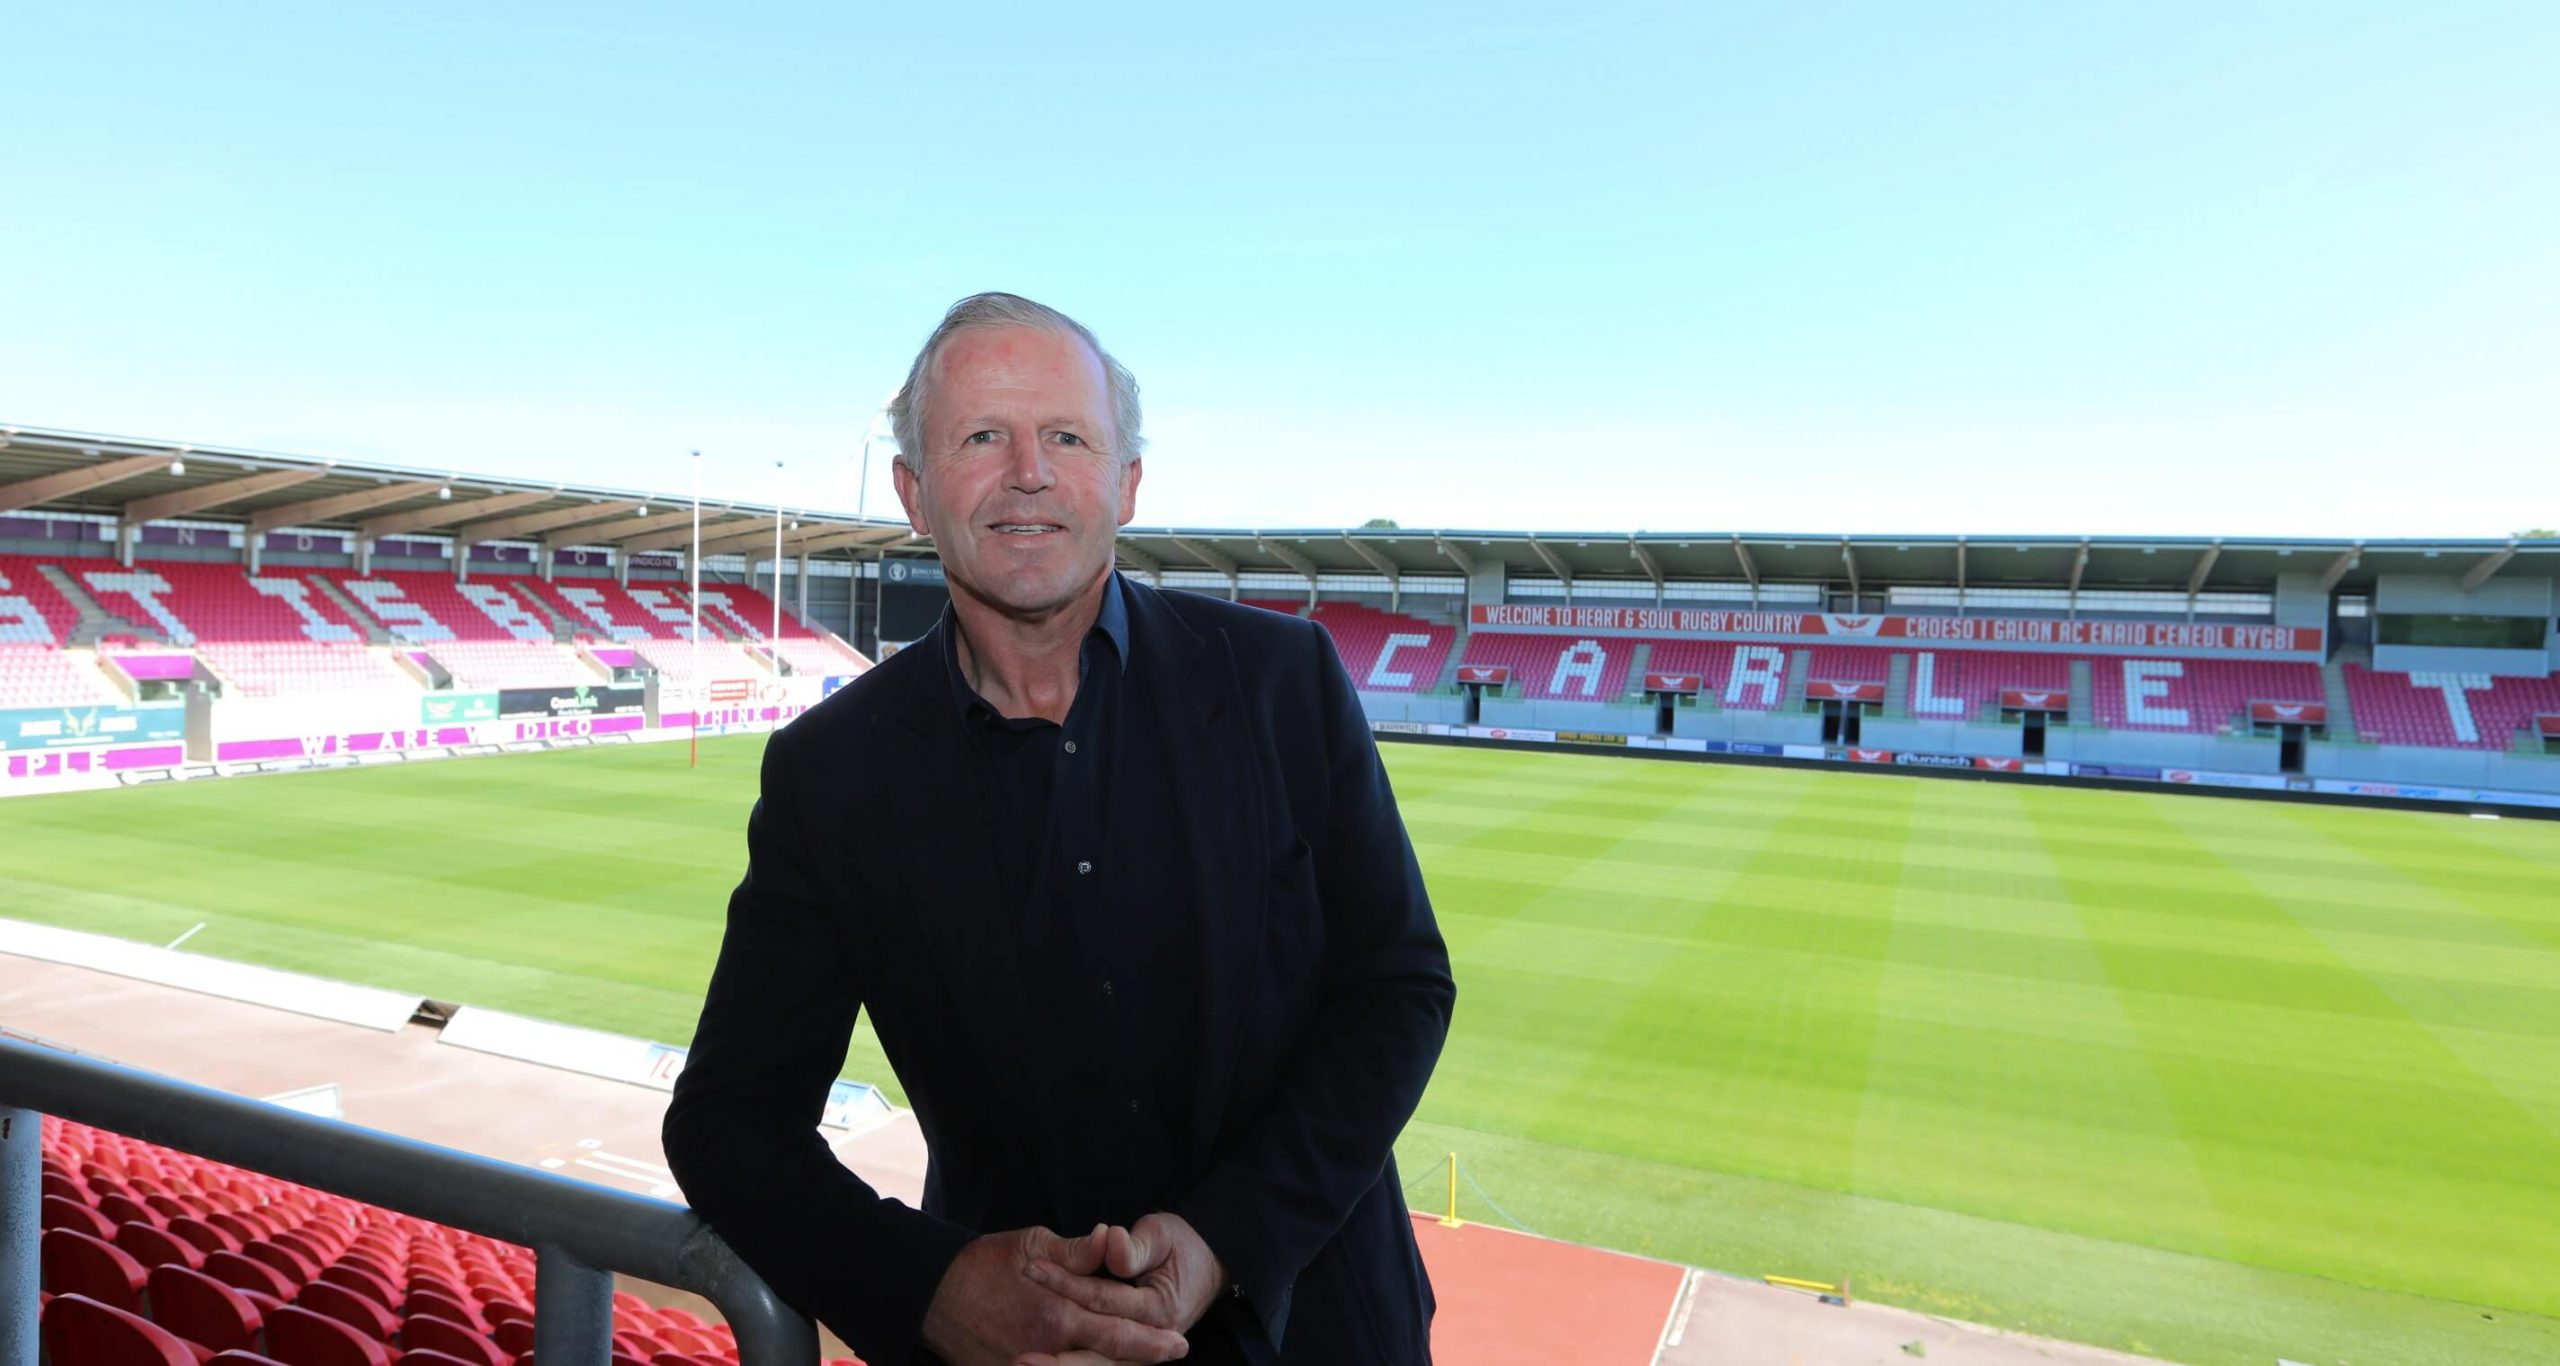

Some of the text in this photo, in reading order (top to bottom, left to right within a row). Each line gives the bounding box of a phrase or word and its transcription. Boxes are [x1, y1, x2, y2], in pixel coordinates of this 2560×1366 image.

[1486, 606, 1802, 634] WELCOME TO HEART & SOUL RUGBY COUNTRY
[1904, 617, 1974, 640] CROESO
[1980, 619, 1988, 641] I
[1993, 620, 2051, 642] GALON
[2058, 622, 2084, 643] AC
[2090, 623, 2148, 645] ENAID
[2232, 627, 2296, 651] RYGBI
[300, 719, 592, 755] WE ARE VDICO
